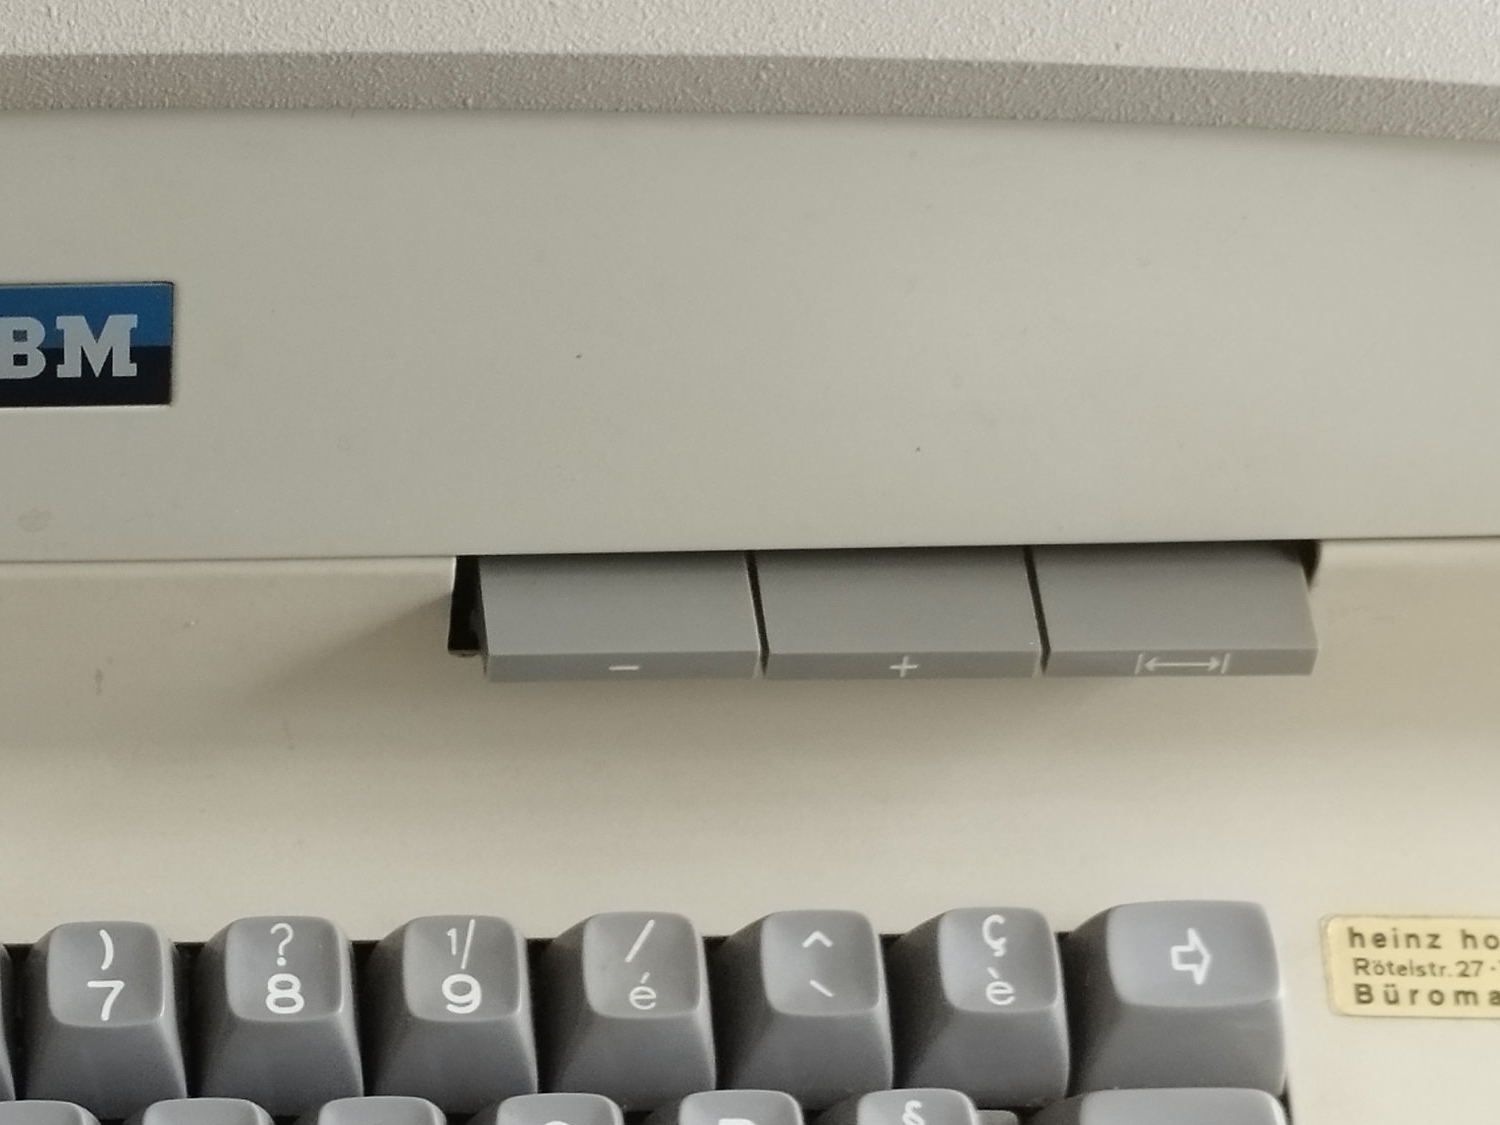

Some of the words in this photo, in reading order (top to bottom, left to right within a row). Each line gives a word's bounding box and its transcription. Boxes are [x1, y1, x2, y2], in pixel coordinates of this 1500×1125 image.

[98, 928, 115, 971] )
[269, 922, 295, 967] ?
[624, 919, 656, 963] /
[1348, 926, 1442, 949] heinz
[86, 979, 126, 1022] 7
[265, 972, 306, 1015] 8
[441, 973, 483, 1015] 9
[628, 971, 657, 1011] é
[985, 966, 1016, 1006] è
